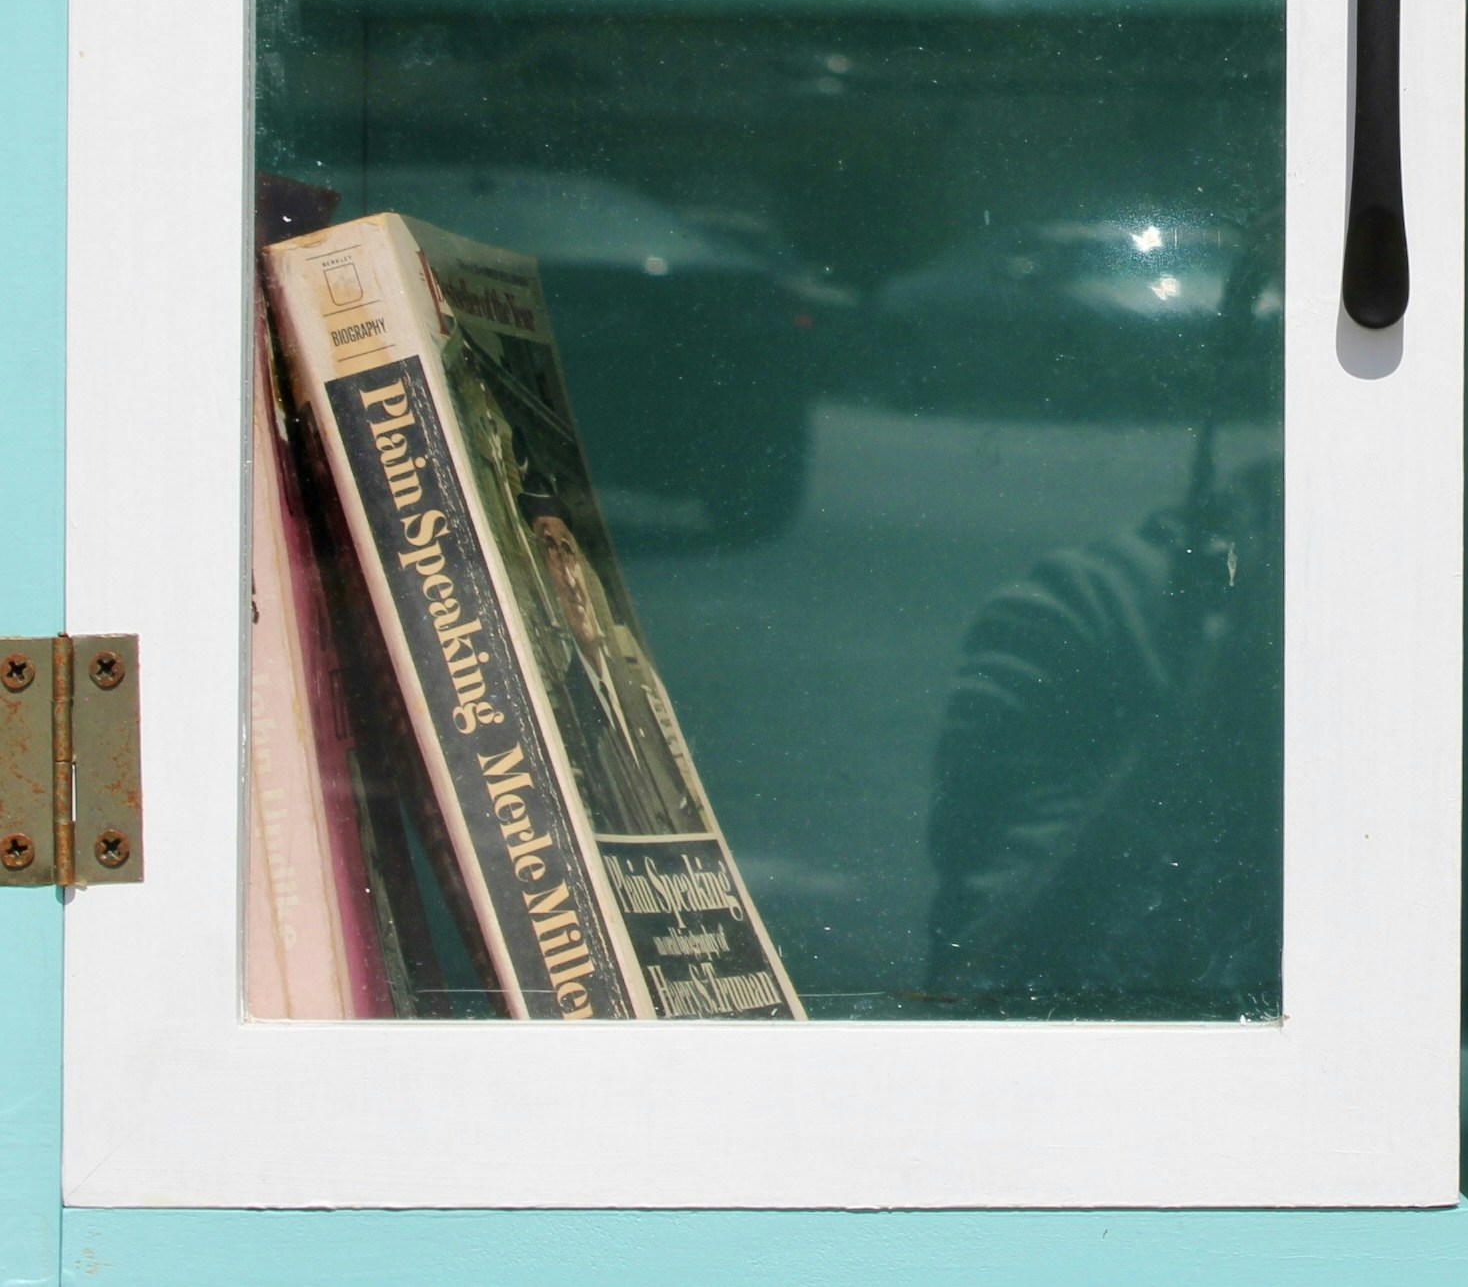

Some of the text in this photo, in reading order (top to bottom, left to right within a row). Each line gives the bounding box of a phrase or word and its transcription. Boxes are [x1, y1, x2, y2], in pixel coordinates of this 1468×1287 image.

[331, 317, 387, 347] BIOGRAPHY
[359, 378, 505, 735] Plain Speaking
[477, 742, 553, 883] Merle
[603, 854, 744, 928] Plain Speaking
[701, 962, 783, 1013] Truman
